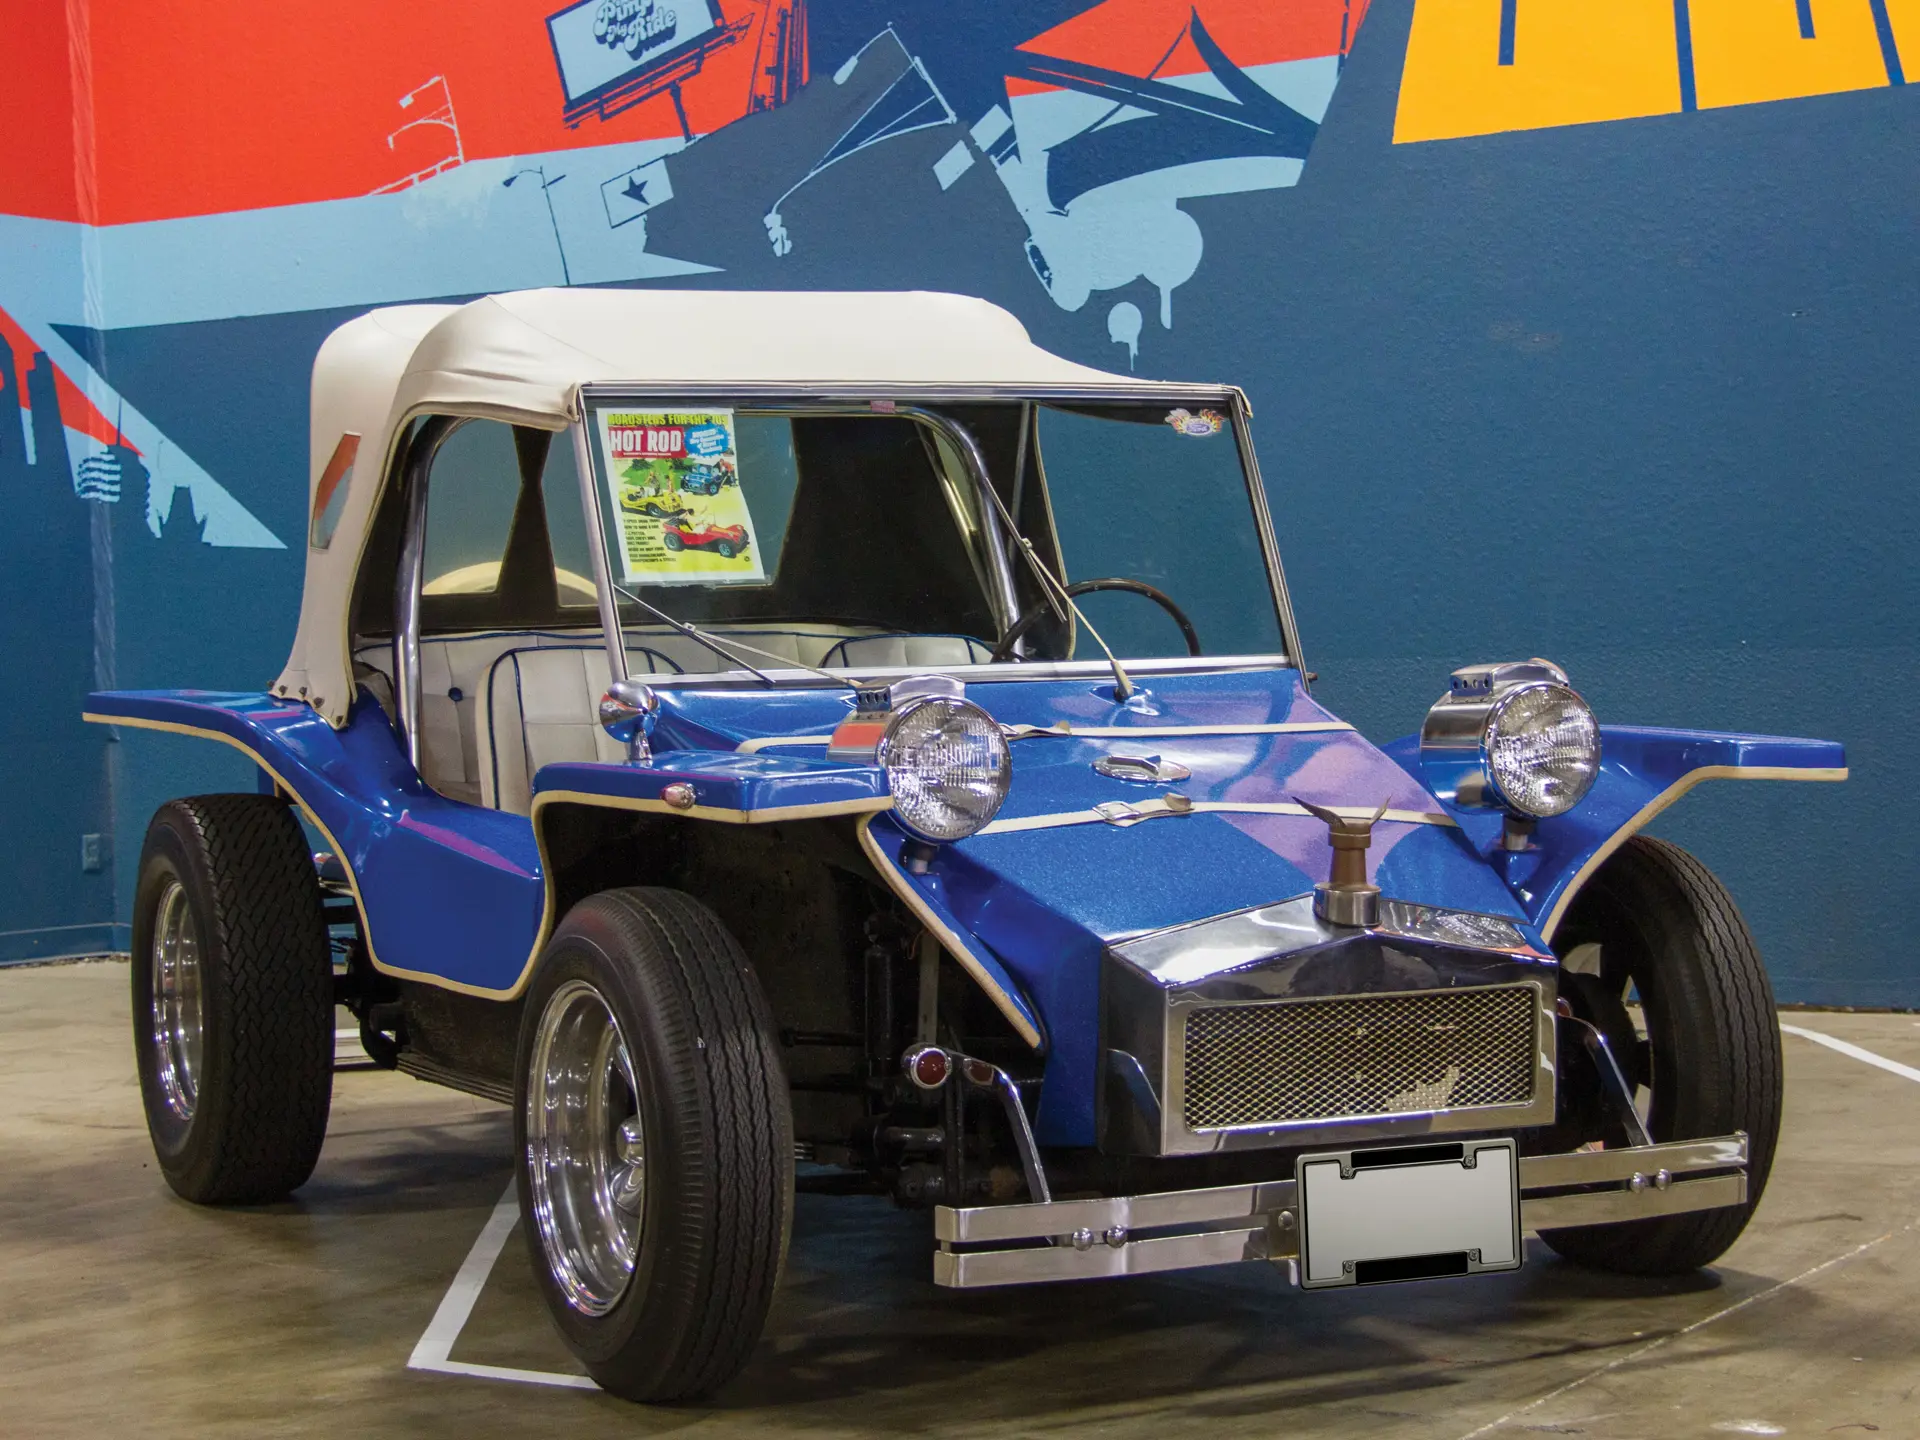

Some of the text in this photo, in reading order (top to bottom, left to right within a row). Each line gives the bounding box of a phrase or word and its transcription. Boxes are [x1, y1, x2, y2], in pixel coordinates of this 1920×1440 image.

[606, 6, 678, 53] My Ride
[610, 430, 643, 452] HOT
[647, 430, 681, 452] ROD
